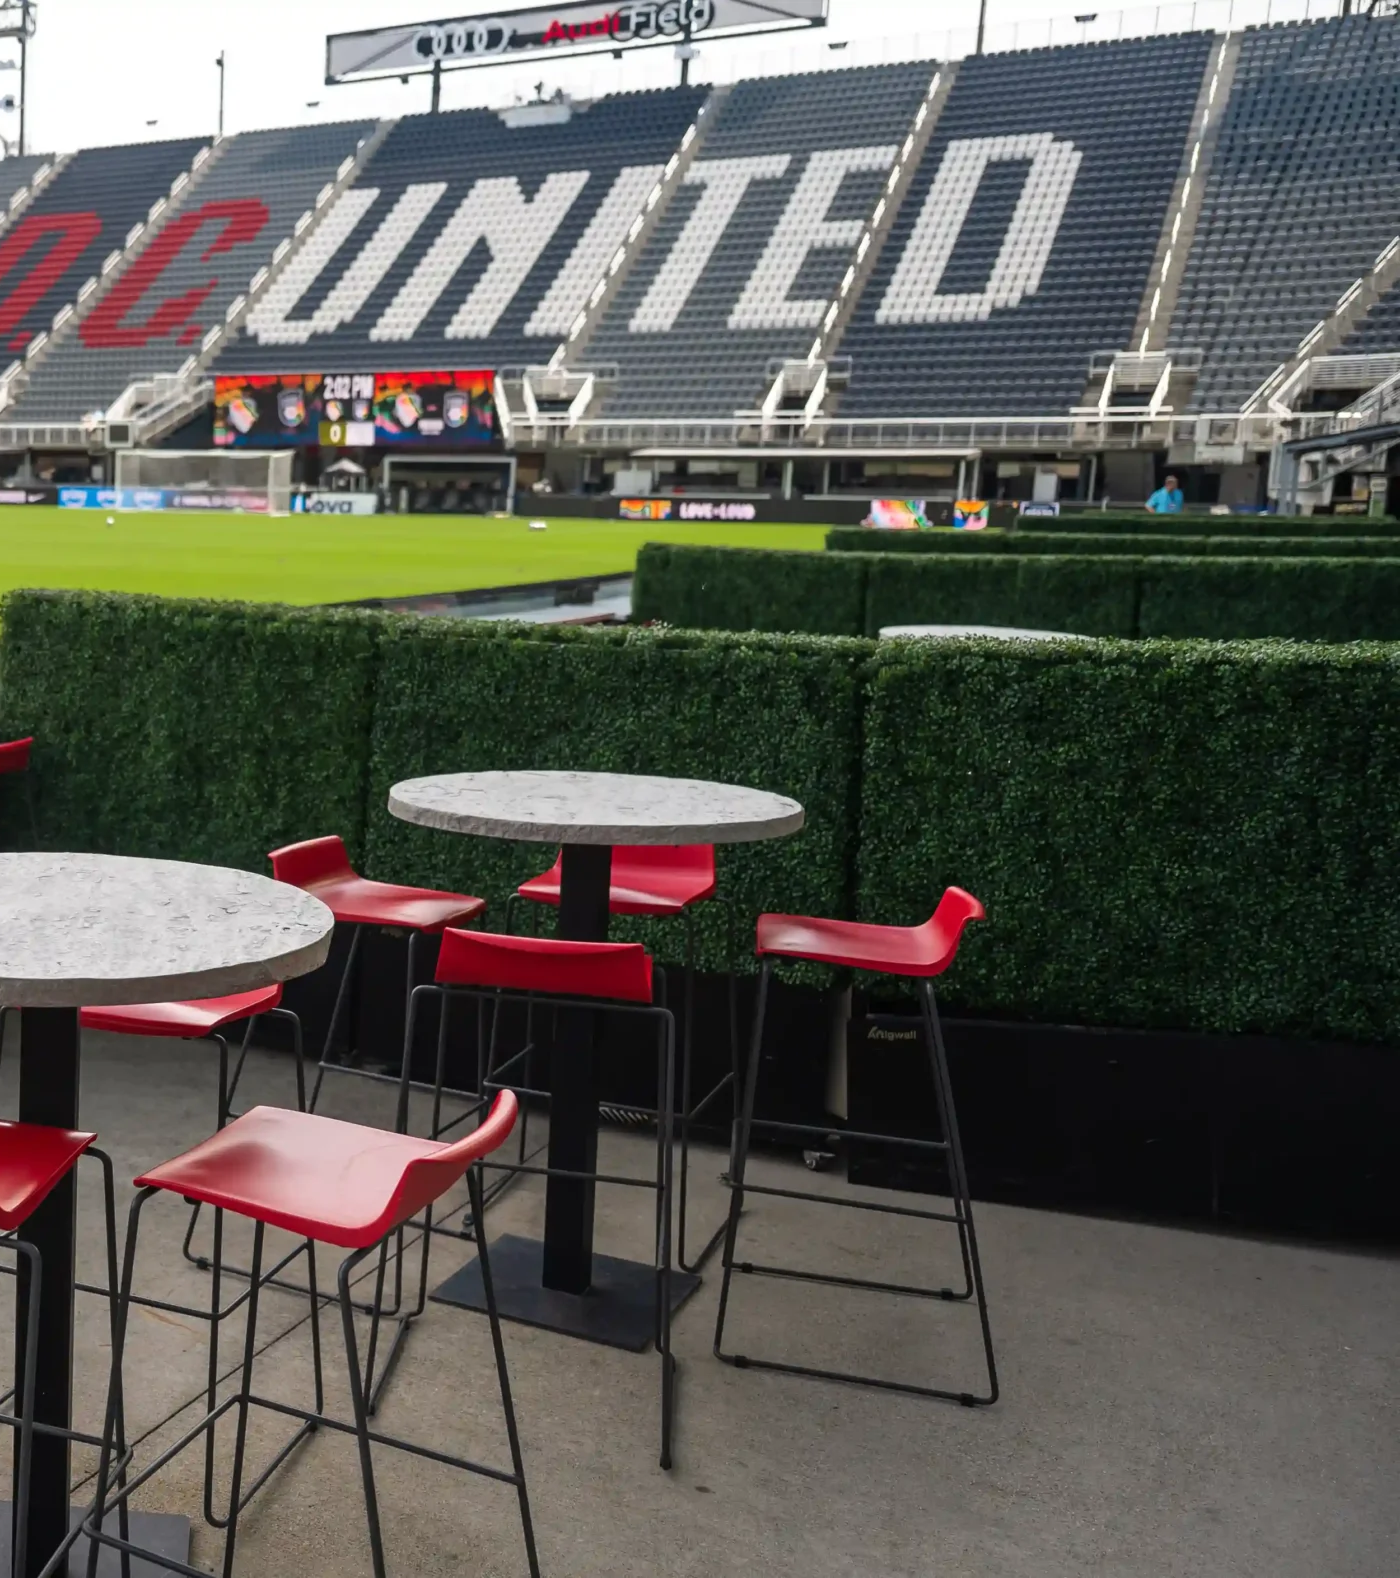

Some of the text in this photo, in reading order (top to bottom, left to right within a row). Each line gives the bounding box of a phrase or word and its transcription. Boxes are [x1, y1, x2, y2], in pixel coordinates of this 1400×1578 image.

[541, 0, 710, 44] Audi Field
[246, 132, 1083, 345] UNITED
[352, 375, 374, 399] PM
[329, 424, 342, 444] 0
